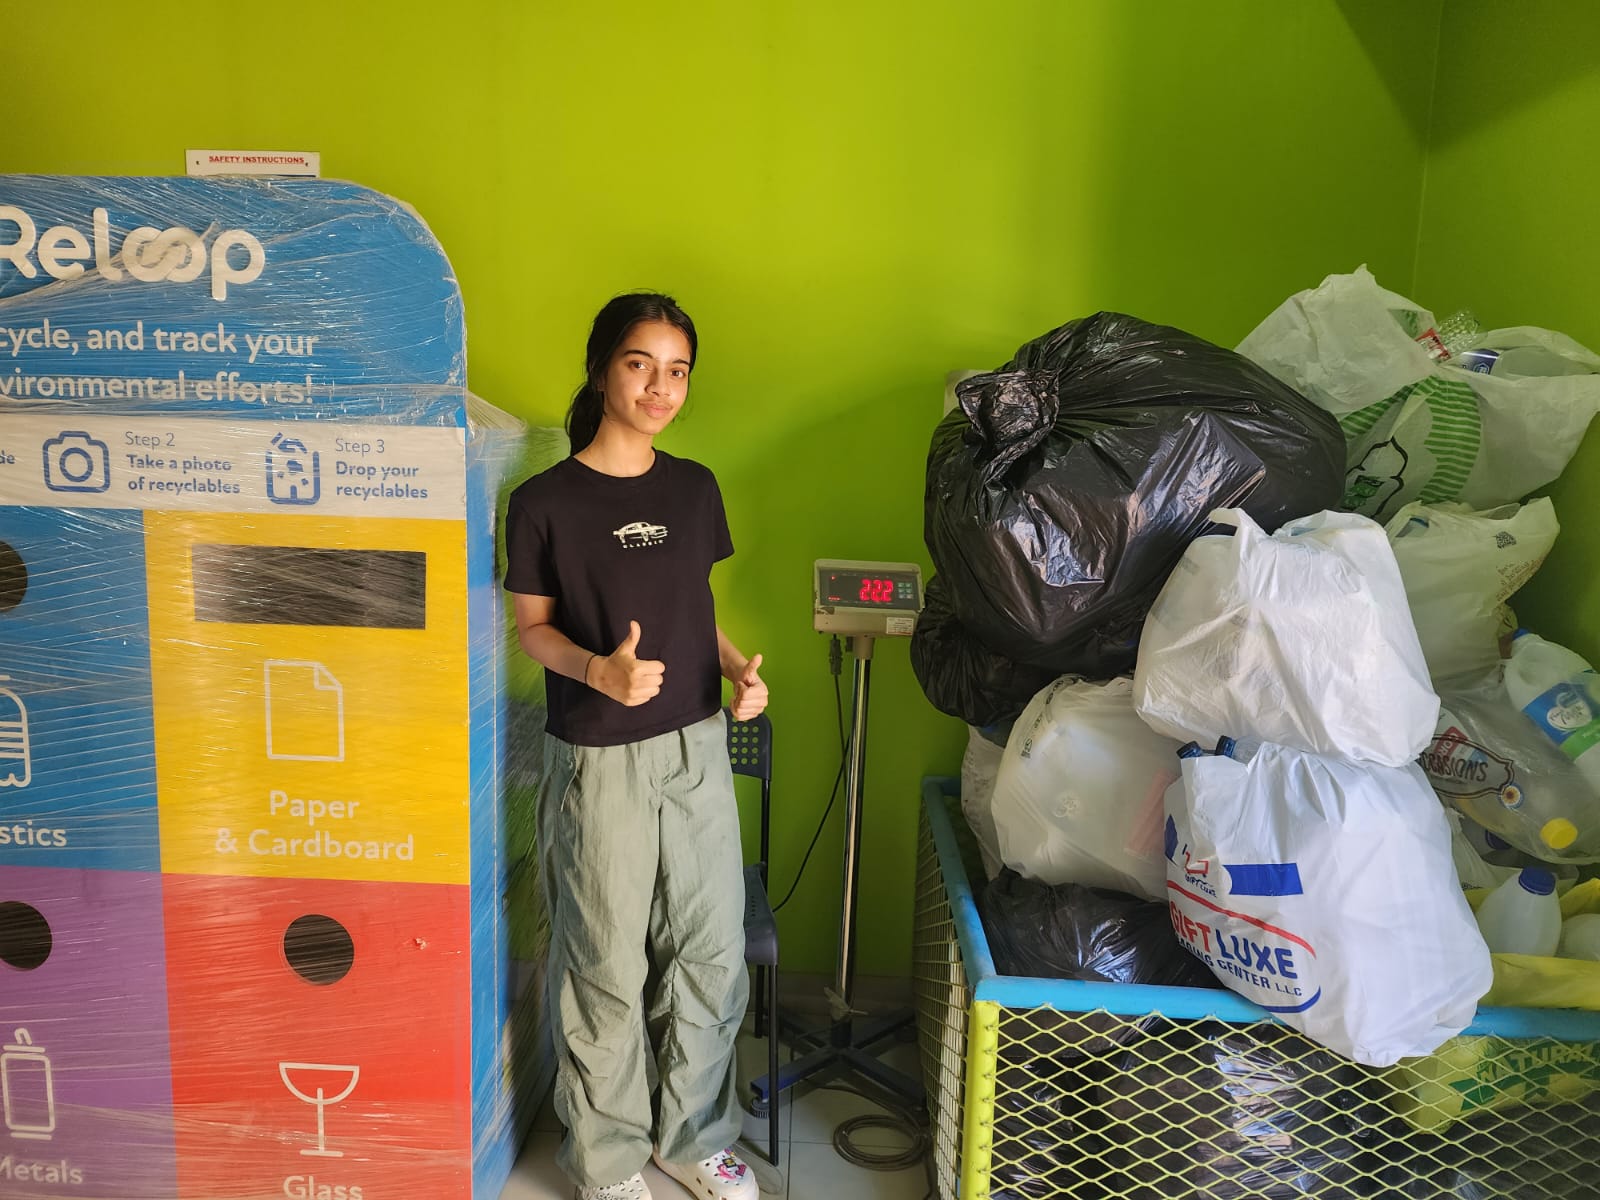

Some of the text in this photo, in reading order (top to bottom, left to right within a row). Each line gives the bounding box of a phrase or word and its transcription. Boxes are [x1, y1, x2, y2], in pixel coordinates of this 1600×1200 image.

[209, 155, 304, 165] SAFETY INSTRUCTIONS
[0, 205, 266, 302] Reloop
[87, 320, 144, 351] and
[153, 323, 237, 354] track
[245, 332, 319, 363] your
[0, 367, 314, 404] vironmental efforts!
[125, 431, 175, 450] Step 2
[335, 438, 386, 455] Step 3
[126, 454, 232, 474] Take a photo
[336, 461, 419, 479] Drop your
[128, 476, 241, 496] of recyclables
[336, 483, 429, 500] recyclables
[269, 790, 360, 826] Paper
[0, 821, 67, 847] stics
[215, 829, 414, 862] & Cardboard
[1215, 929, 1298, 979] LUXE
[1217, 959, 1271, 989] CENTER
[0, 1157, 83, 1185] Metals
[283, 1174, 363, 1200] Glass
